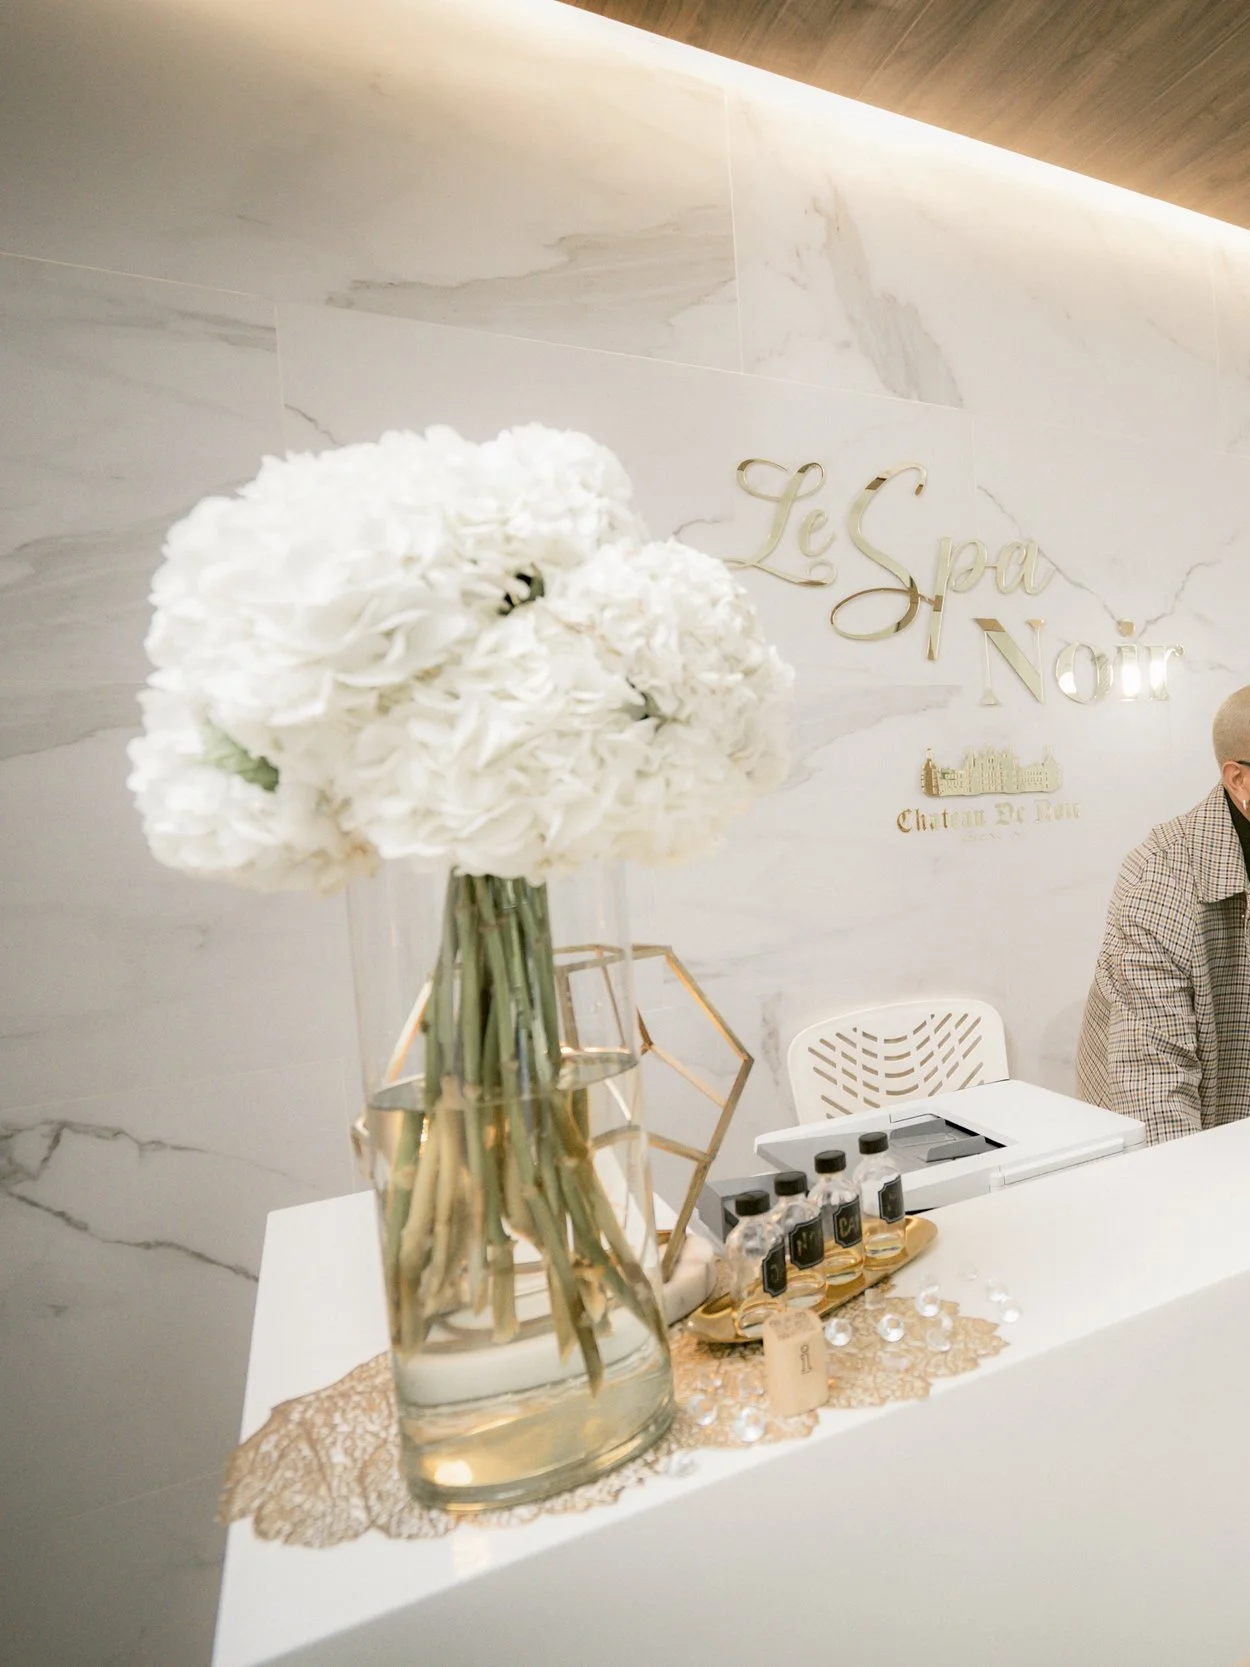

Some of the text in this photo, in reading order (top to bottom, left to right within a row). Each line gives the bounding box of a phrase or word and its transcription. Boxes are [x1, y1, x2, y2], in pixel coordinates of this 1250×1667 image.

[721, 457, 1057, 662] Le Spa
[972, 617, 1186, 706] Noir
[896, 807, 986, 834] Chateau
[994, 801, 1027, 826] De
